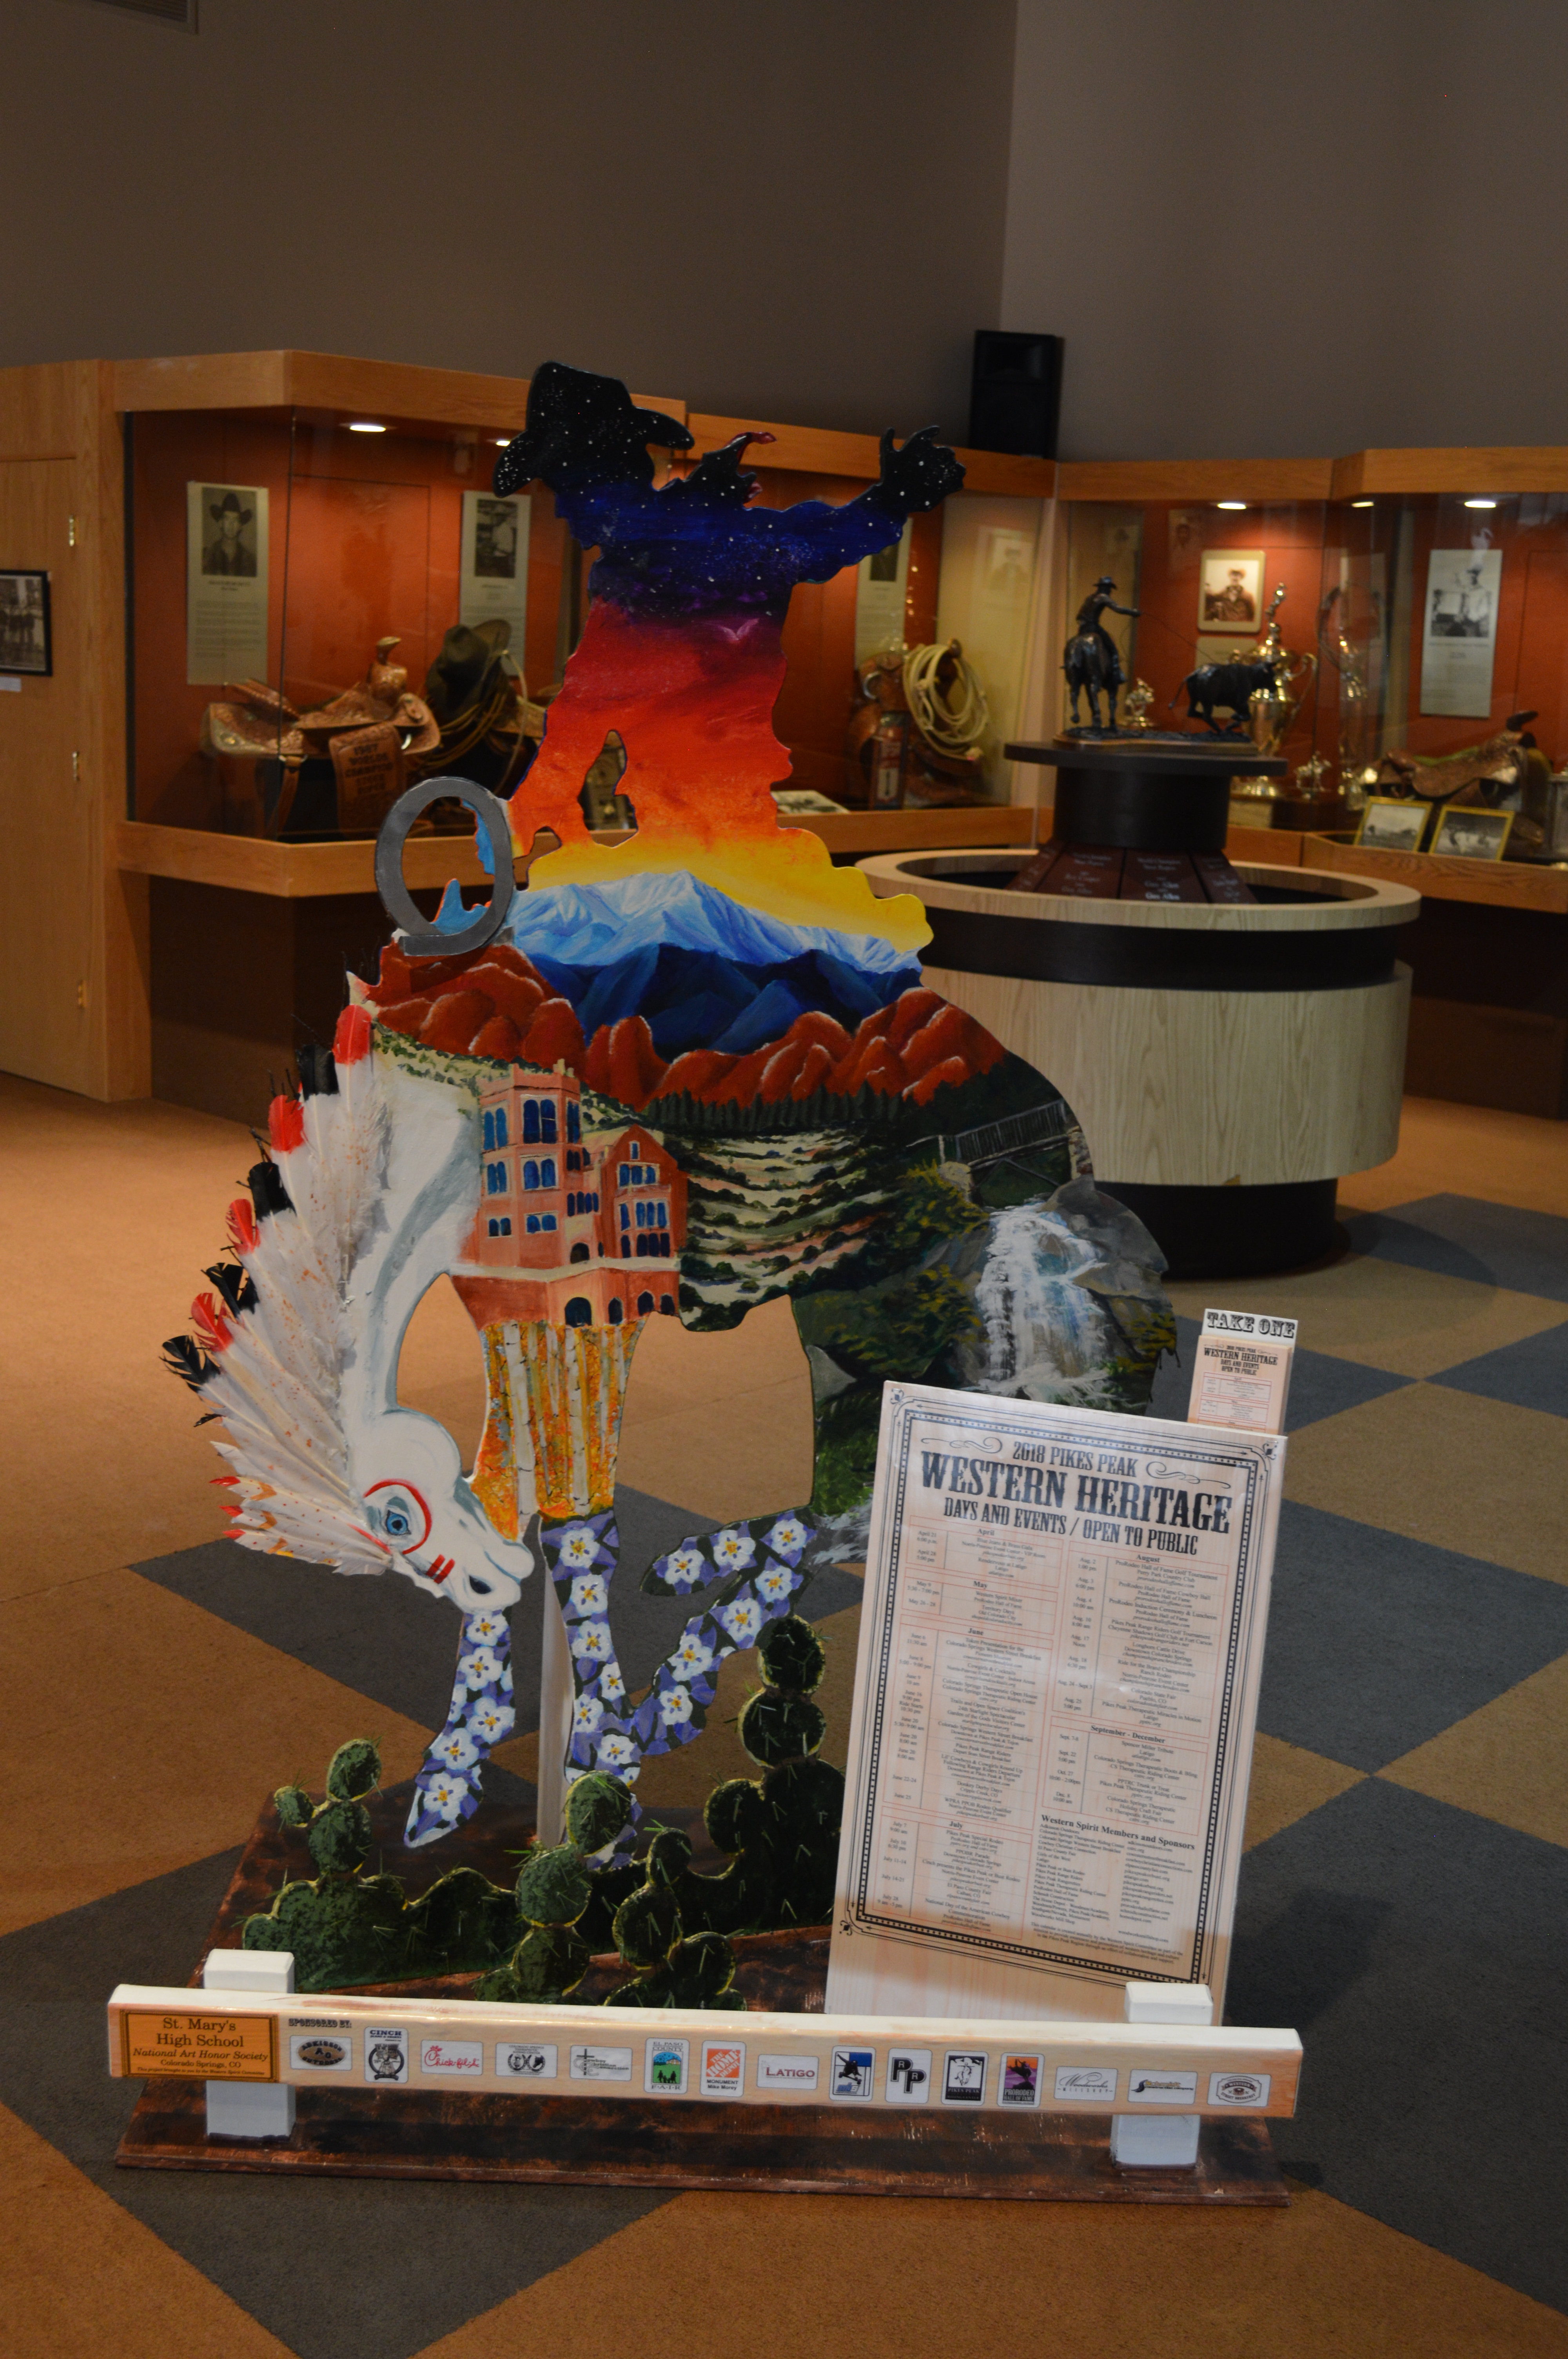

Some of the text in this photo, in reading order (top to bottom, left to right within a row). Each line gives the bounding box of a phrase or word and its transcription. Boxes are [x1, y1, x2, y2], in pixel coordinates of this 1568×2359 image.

[1207, 1312, 1296, 1339] TAKE ONE
[1204, 1347, 1278, 1365] WESTERN HERITAGE
[1012, 1442, 1138, 1478] 2018 PIKES PEAK
[921, 1450, 1232, 1534] WESTERN HERITAGE
[943, 1497, 1198, 1555] DAYS AND EVENTS / OPEN TO PUBLIC
[1136, 1554, 1160, 1563] August
[1115, 1560, 1140, 1568] ProRodeo
[1187, 1571, 1218, 1581] Tournament
[973, 1581, 987, 1590] May
[1109, 1598, 1134, 1607] ProRodeo
[1134, 1602, 1158, 1610] Induction
[1158, 1607, 1185, 1616] Ceremony
[1192, 1611, 1217, 1620] Luncheon
[1182, 1631, 1210, 1639] Tournament
[1132, 1642, 1156, 1650] Longhorn
[1091, 1725, 1126, 1736] September
[1132, 1732, 1165, 1743] December
[1119, 1765, 1146, 1774] Therapeutic
[1147, 1770, 1163, 1779] Riding
[949, 1821, 963, 1830] July
[1041, 1814, 1074, 1827] Western
[1076, 1821, 1099, 1832] Spirit
[1102, 1826, 1139, 1839] Members
[1158, 1837, 1195, 1850] Sponsors
[163, 2017, 236, 2033] St. Mary's
[289, 2019, 338, 2027] SPONSORED
[156, 2033, 244, 2048] High School
[133, 2048, 269, 2061] National Art Honor Society
[710, 2051, 725, 2063] THE
[196, 2061, 227, 2069] Springs,
[707, 2049, 740, 2077] HOME
[718, 2061, 740, 2077] DEPOT
[1059, 2072, 1108, 2088] Woodworks
